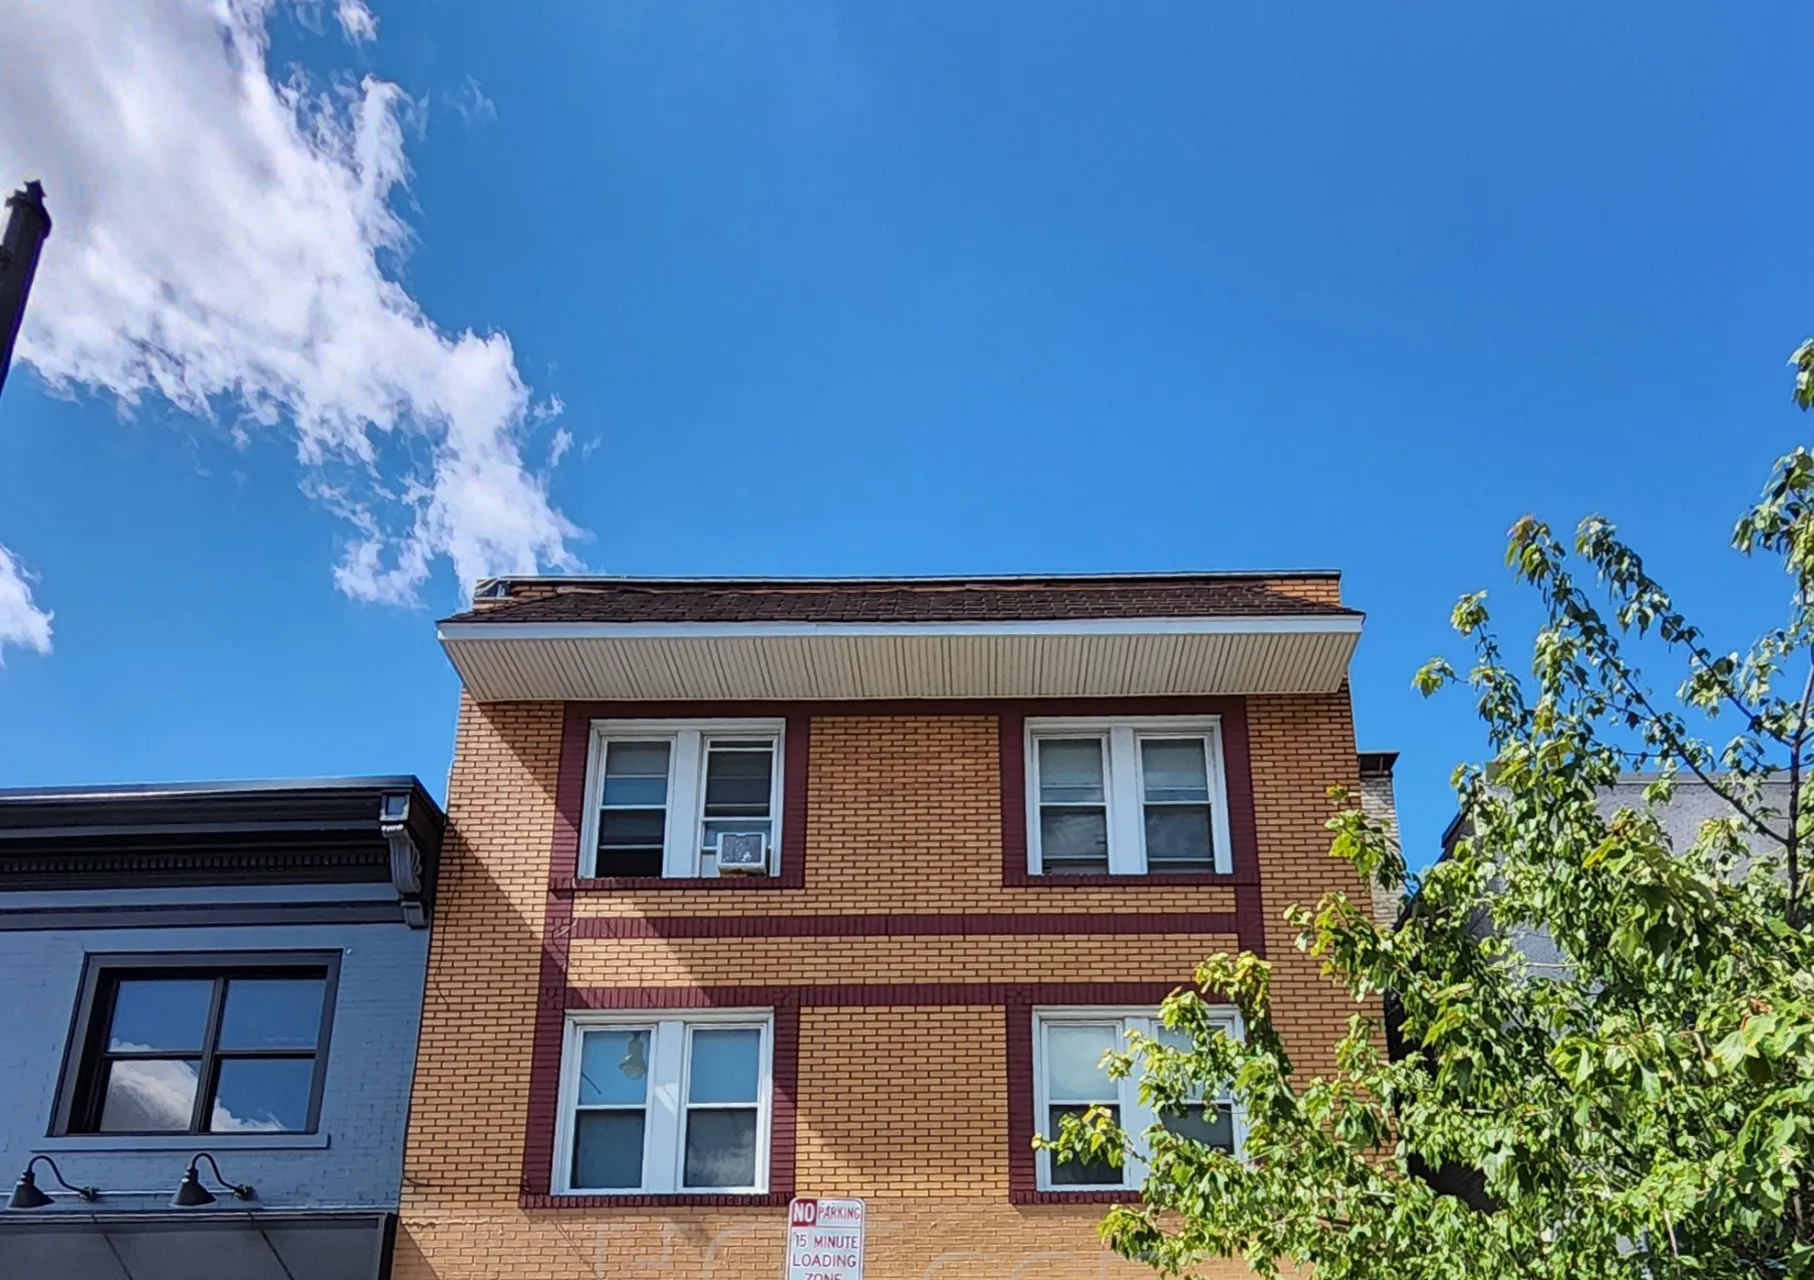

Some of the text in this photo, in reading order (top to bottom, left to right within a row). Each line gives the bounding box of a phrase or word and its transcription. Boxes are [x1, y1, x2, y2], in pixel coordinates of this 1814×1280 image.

[793, 1202, 860, 1222] NO PARKING
[794, 1233, 858, 1249] 15 MINUTE
[793, 1254, 856, 1267] LOADING
